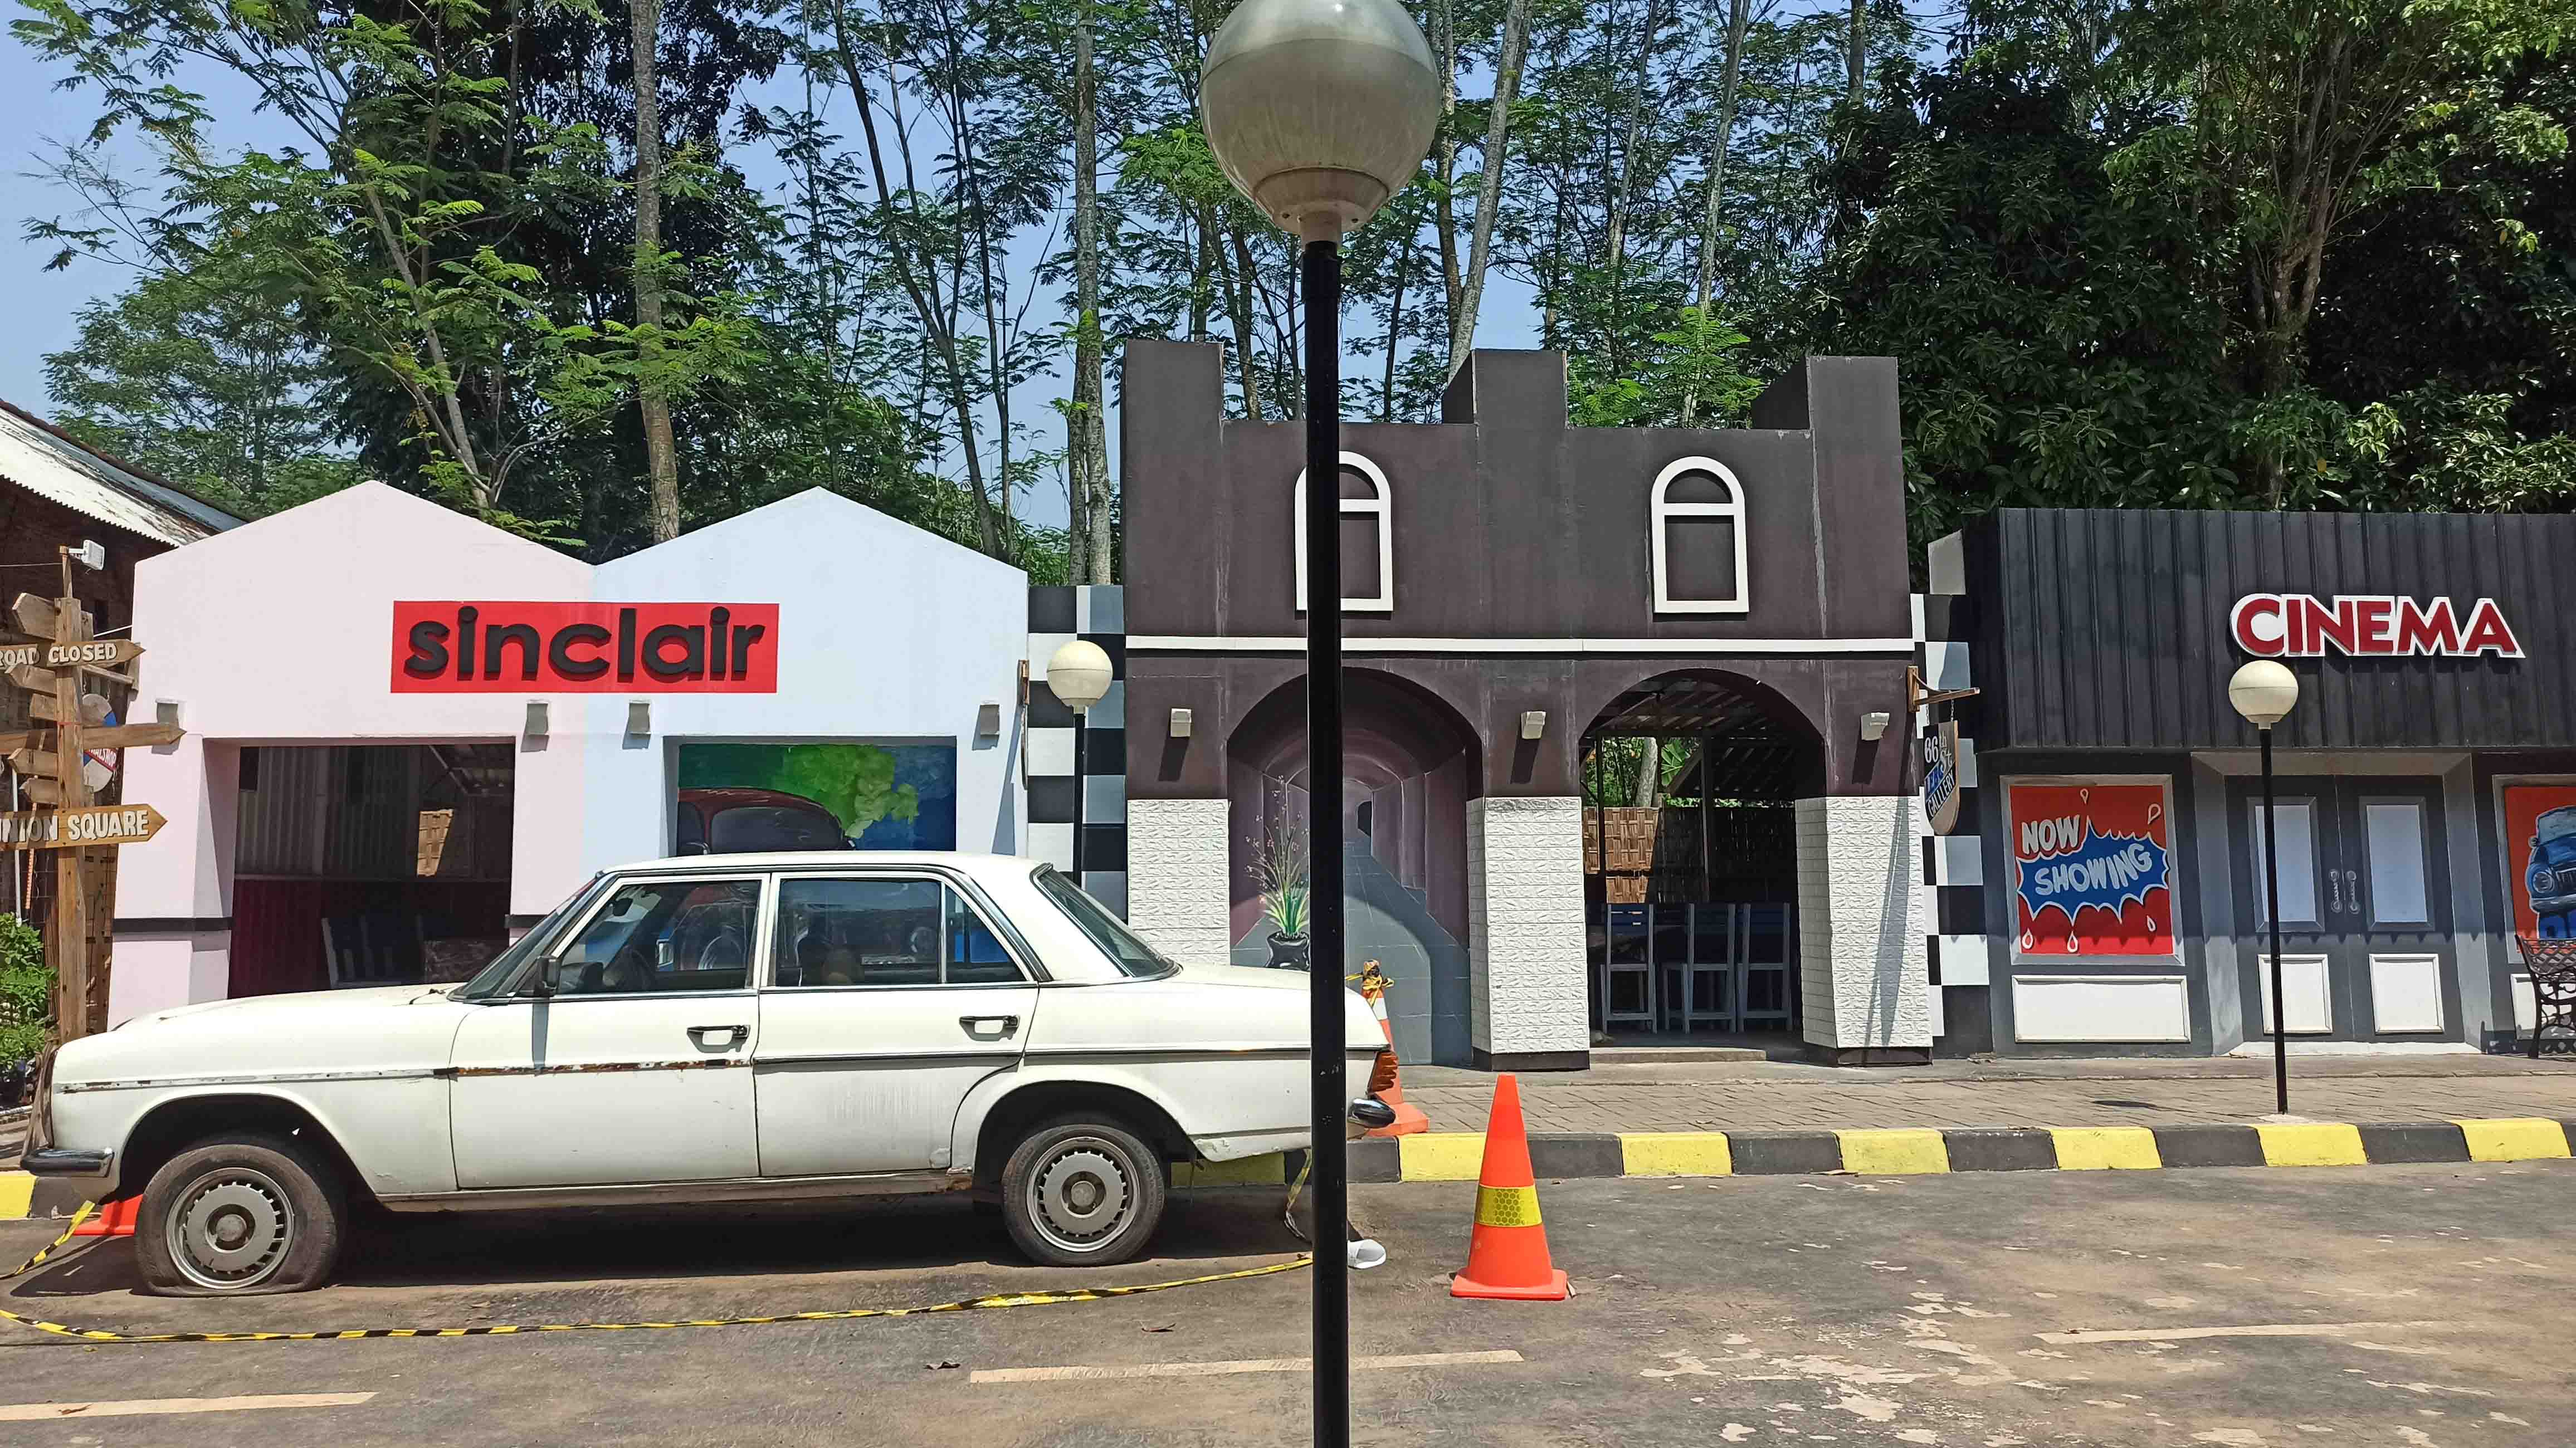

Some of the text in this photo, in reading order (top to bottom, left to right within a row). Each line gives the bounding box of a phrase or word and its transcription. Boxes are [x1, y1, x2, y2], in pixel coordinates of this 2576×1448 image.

[404, 605, 765, 681] sinclair
[2231, 593, 2526, 658] CINEMA
[48, 643, 117, 663] CLOSED
[0, 810, 149, 842] NION SQUARE
[2021, 815, 2080, 855] NOW
[2035, 843, 2153, 895] SHOWING
